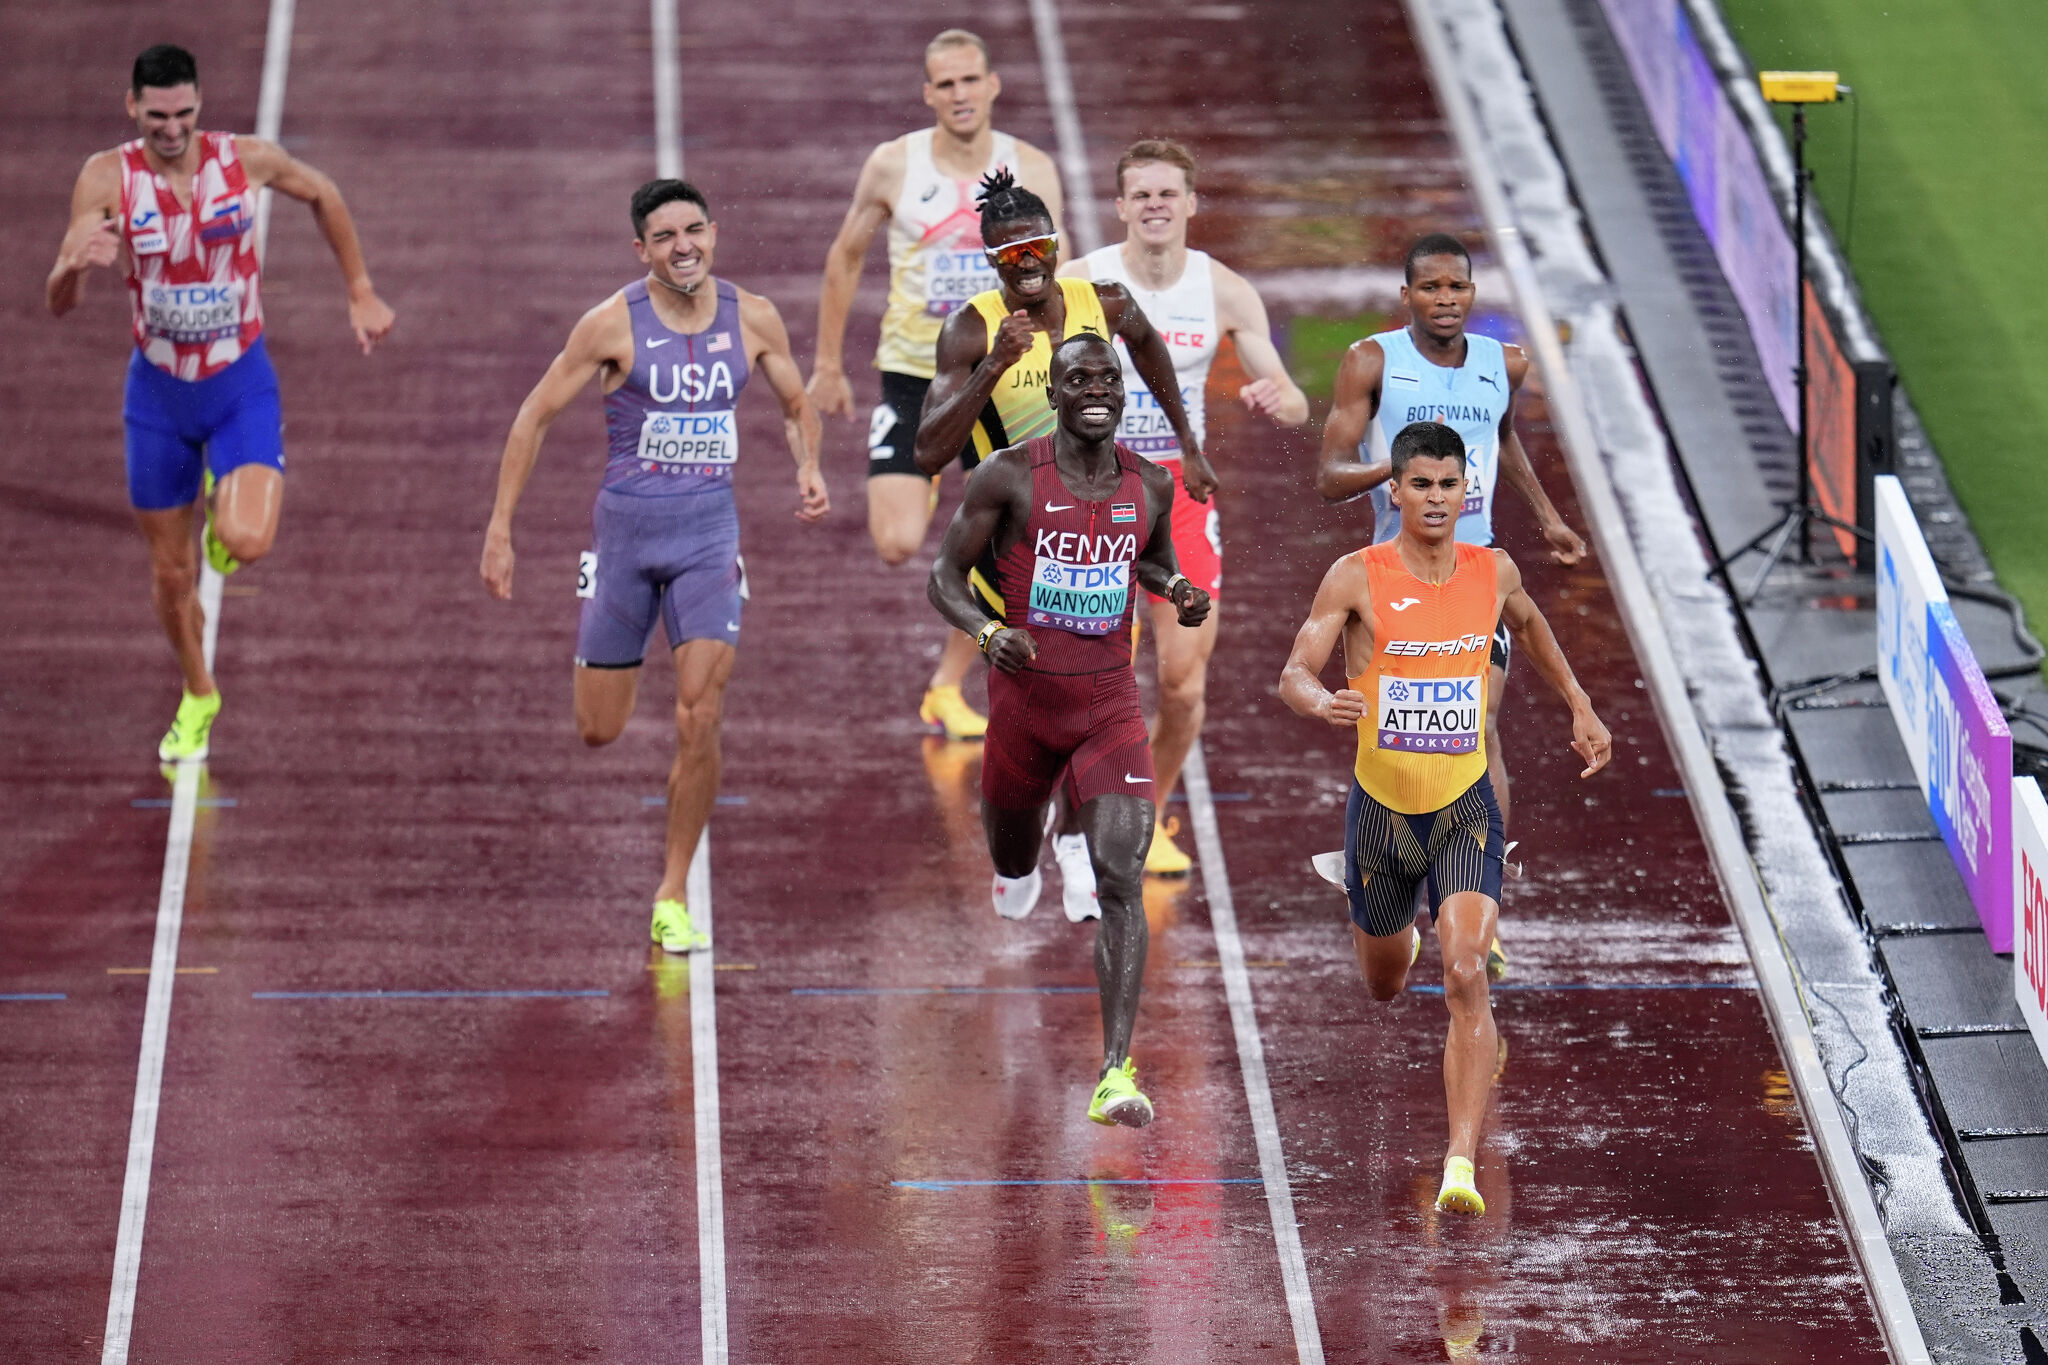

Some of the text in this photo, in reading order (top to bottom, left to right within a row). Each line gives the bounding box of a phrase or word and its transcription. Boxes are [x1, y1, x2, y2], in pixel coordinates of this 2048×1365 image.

[955, 253, 989, 271] TD
[169, 286, 229, 305] TDK
[649, 360, 734, 404] USA
[672, 415, 729, 435] TDK
[1406, 404, 1491, 424] BOTSWANA
[645, 437, 732, 459] HOPPEL
[1034, 528, 1137, 563] KENYA
[1063, 565, 1123, 588] TDK
[1036, 586, 1125, 615] WANYONYI
[1383, 633, 1489, 657] ESPAÑA
[1409, 679, 1475, 702] TDK
[1384, 707, 1477, 732] ATTAOUI
[2022, 847, 2048, 1020] HO
